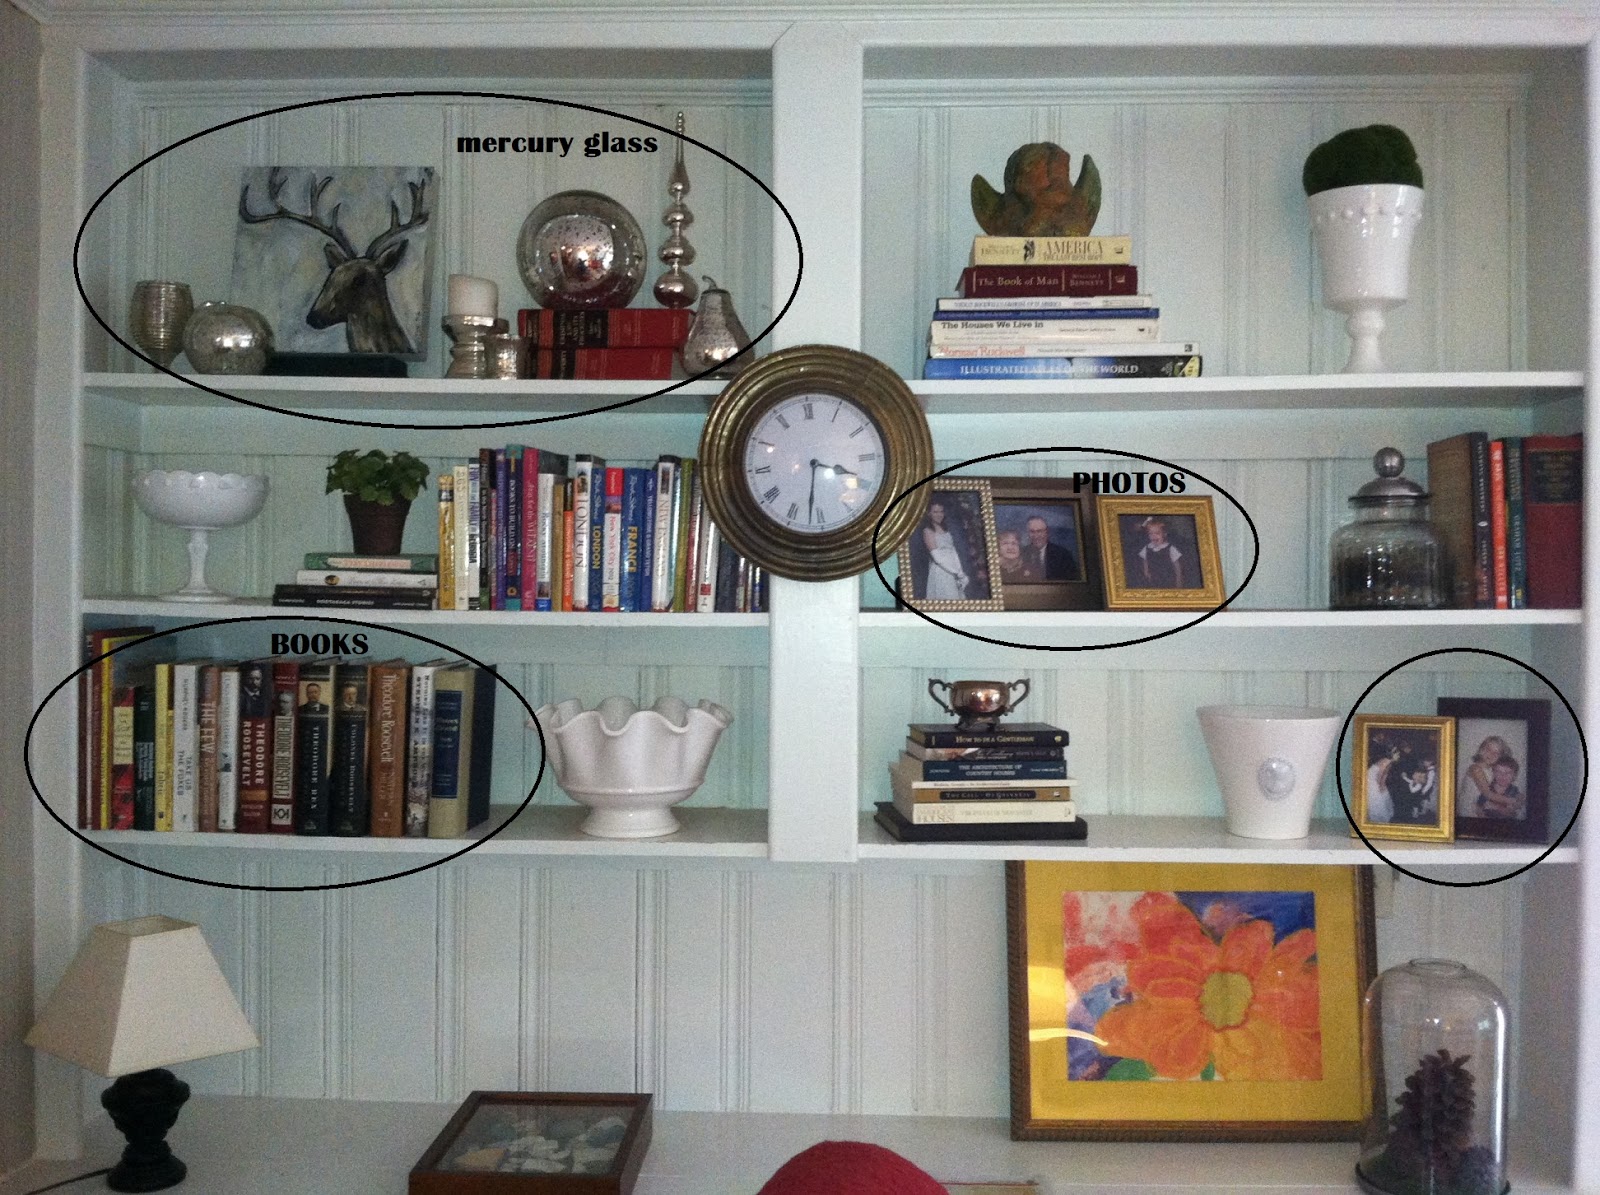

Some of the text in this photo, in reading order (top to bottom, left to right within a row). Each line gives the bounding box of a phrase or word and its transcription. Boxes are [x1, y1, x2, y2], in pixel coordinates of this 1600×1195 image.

[1045, 240, 1104, 254] AMERICA
[978, 276, 1059, 286] The Book of Man
[941, 321, 959, 329] The
[961, 321, 994, 329] Houses
[996, 321, 1011, 329] We
[1013, 320, 1032, 328] Live
[1098, 365, 1139, 374] WORLD
[576, 499, 588, 568] LONDON
[592, 526, 602, 569] LONDON
[627, 526, 638, 573] FRANCE
[201, 701, 216, 725] THE
[380, 674, 400, 763] Theodore Roosevelt
[200, 728, 216, 753] FEW
[242, 721, 251, 786] ROOSEVELT
[255, 723, 265, 785] THEODORE
[311, 726, 320, 783] THEODORE
[177, 750, 185, 766] THE
